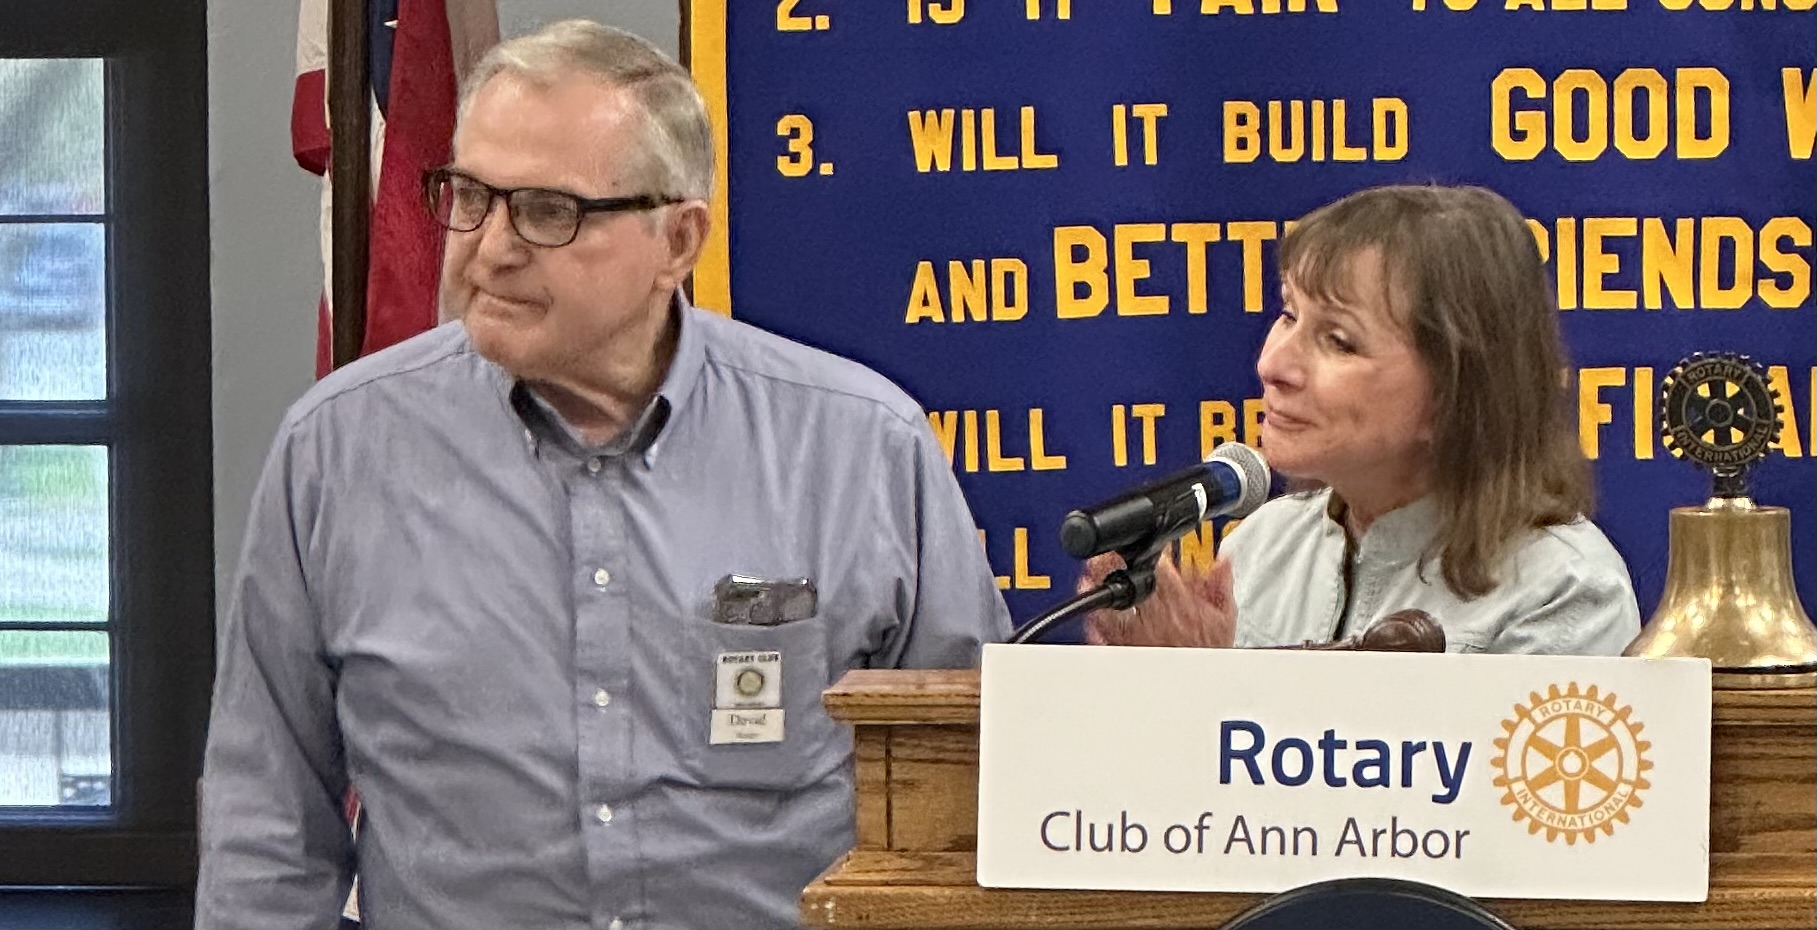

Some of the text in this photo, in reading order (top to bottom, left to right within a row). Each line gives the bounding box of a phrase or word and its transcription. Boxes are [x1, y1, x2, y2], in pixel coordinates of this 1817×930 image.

[776, 114, 834, 177] 3.
[907, 106, 1058, 172] WILL
[1112, 104, 1168, 166] IT
[1223, 98, 1409, 164] BUILD
[1491, 67, 1730, 161] GOOD
[905, 216, 1813, 322] AND BETT IENDS
[1686, 364, 1744, 380] ROTARY
[1112, 403, 1166, 467] IT
[1676, 427, 1768, 461] INTERNATIONAL
[1538, 699, 1608, 718] ROTARY
[1218, 720, 1473, 805] Rotary
[1516, 788, 1629, 828] INTERNATIONAL
[1040, 809, 1471, 859] Club of Ann Arbor
